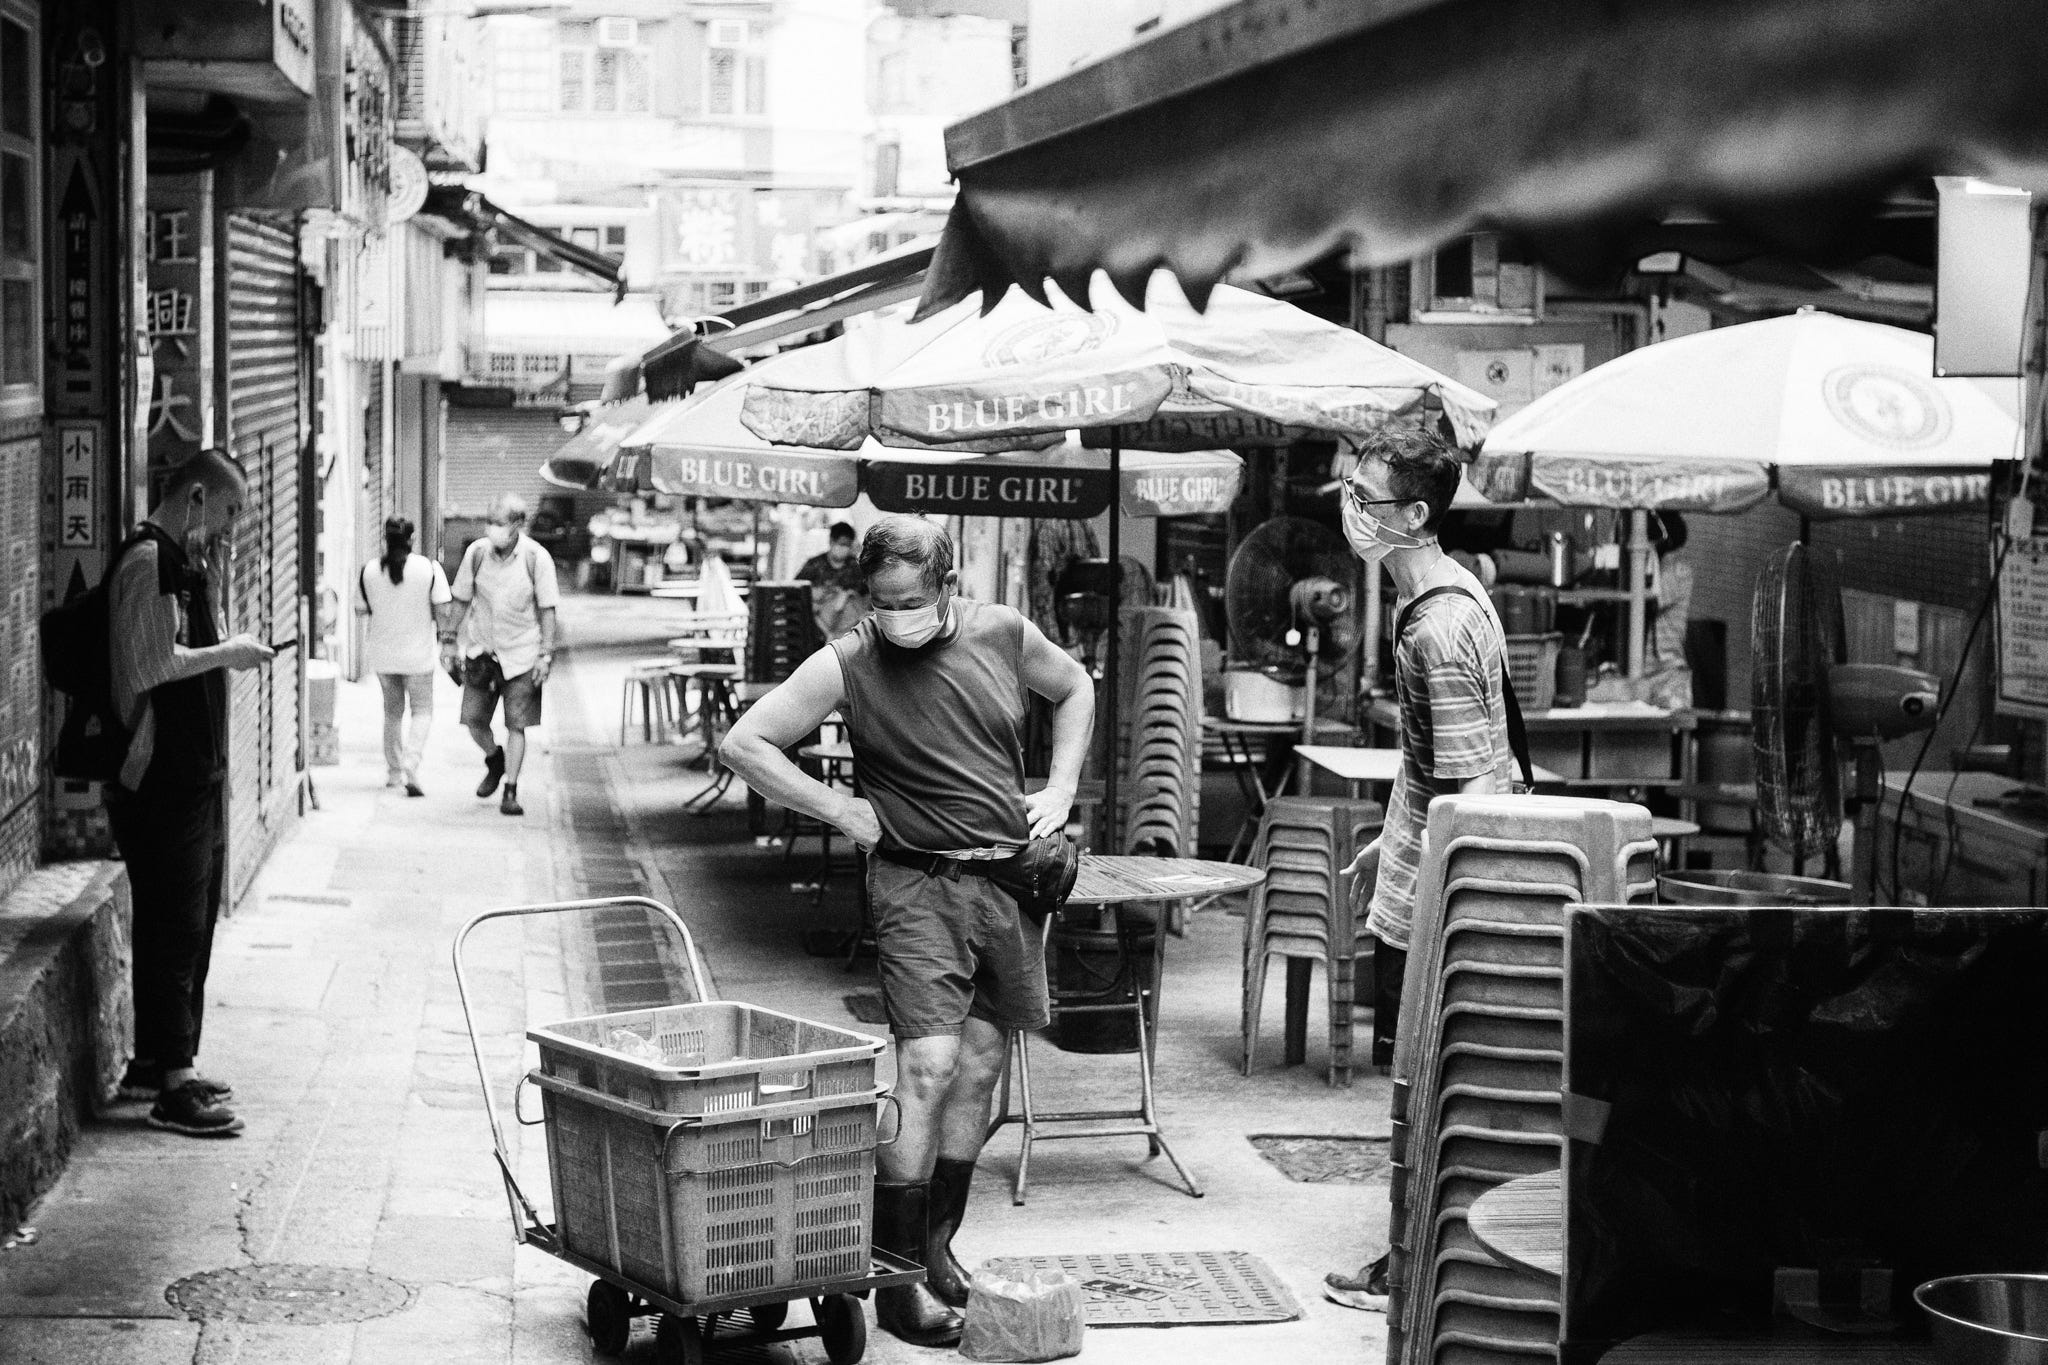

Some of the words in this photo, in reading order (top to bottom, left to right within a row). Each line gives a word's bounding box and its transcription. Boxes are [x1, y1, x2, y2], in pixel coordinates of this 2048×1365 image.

[927, 395, 1027, 433] BLUE
[1037, 384, 1132, 421] GIRL
[65, 434, 91, 542] 小雨天
[681, 457, 753, 489] BLUE
[758, 465, 824, 498] GIRL
[905, 474, 991, 501] BLUE
[999, 476, 1078, 504] GIRL
[1135, 478, 1180, 503] BLUE
[1182, 476, 1221, 503] GIRL
[1821, 475, 1917, 509] BLUE
[1923, 474, 1991, 503] GIR
